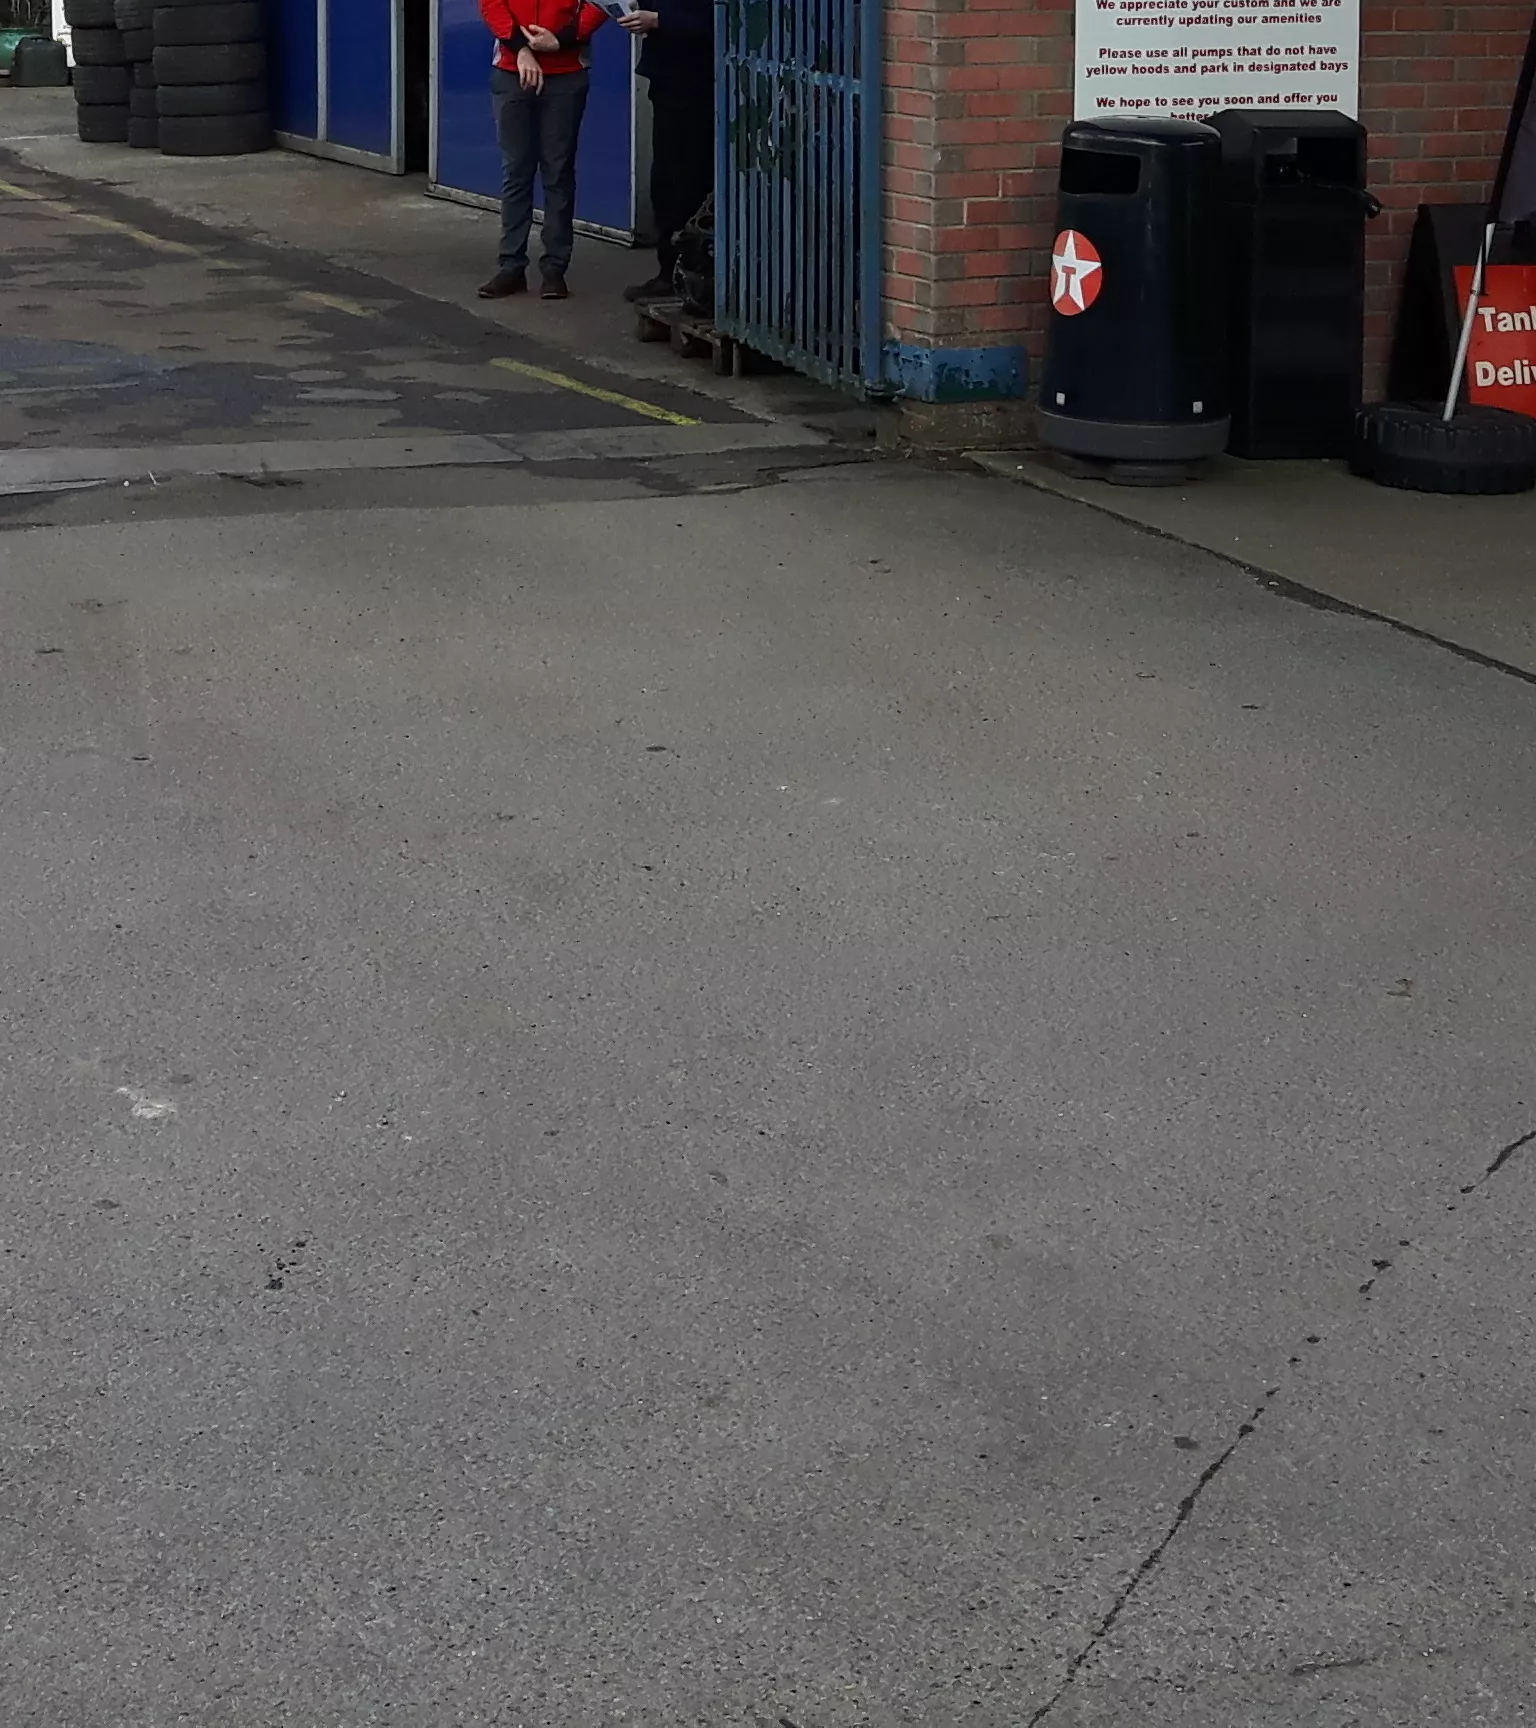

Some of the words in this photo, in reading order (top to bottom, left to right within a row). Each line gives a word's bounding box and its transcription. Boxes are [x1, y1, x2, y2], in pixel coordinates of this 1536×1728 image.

[1096, 0, 1115, 10] We
[1120, 0, 1188, 12] appreciate
[1191, 0, 1220, 11] your
[1300, 0, 1317, 8] we
[1116, 15, 1174, 27] currently
[1178, 14, 1234, 27] updating
[1237, 15, 1257, 24] our
[1261, 13, 1322, 23] amenities
[1099, 47, 1142, 58] Please
[1146, 49, 1168, 58] use
[1172, 47, 1188, 58] all
[1191, 48, 1233, 59] pumps
[1237, 46, 1262, 56] that
[1265, 46, 1281, 56] do
[1285, 46, 1305, 56] not
[1308, 45, 1337, 55] have
[1086, 65, 1127, 77] yellow
[1132, 64, 1169, 74] hoods
[1174, 63, 1197, 74] and
[1201, 62, 1229, 75] park
[1233, 62, 1244, 72] in
[1248, 61, 1316, 73] designated
[1320, 61, 1348, 73] bays
[1096, 97, 1115, 108] We
[1120, 97, 1150, 109] hope
[1154, 97, 1167, 106] to
[1172, 98, 1194, 106] see
[1198, 96, 1220, 109] you
[1224, 95, 1253, 105] soon
[1257, 93, 1279, 104] and
[1283, 93, 1312, 103] offer
[1316, 93, 1338, 105] you
